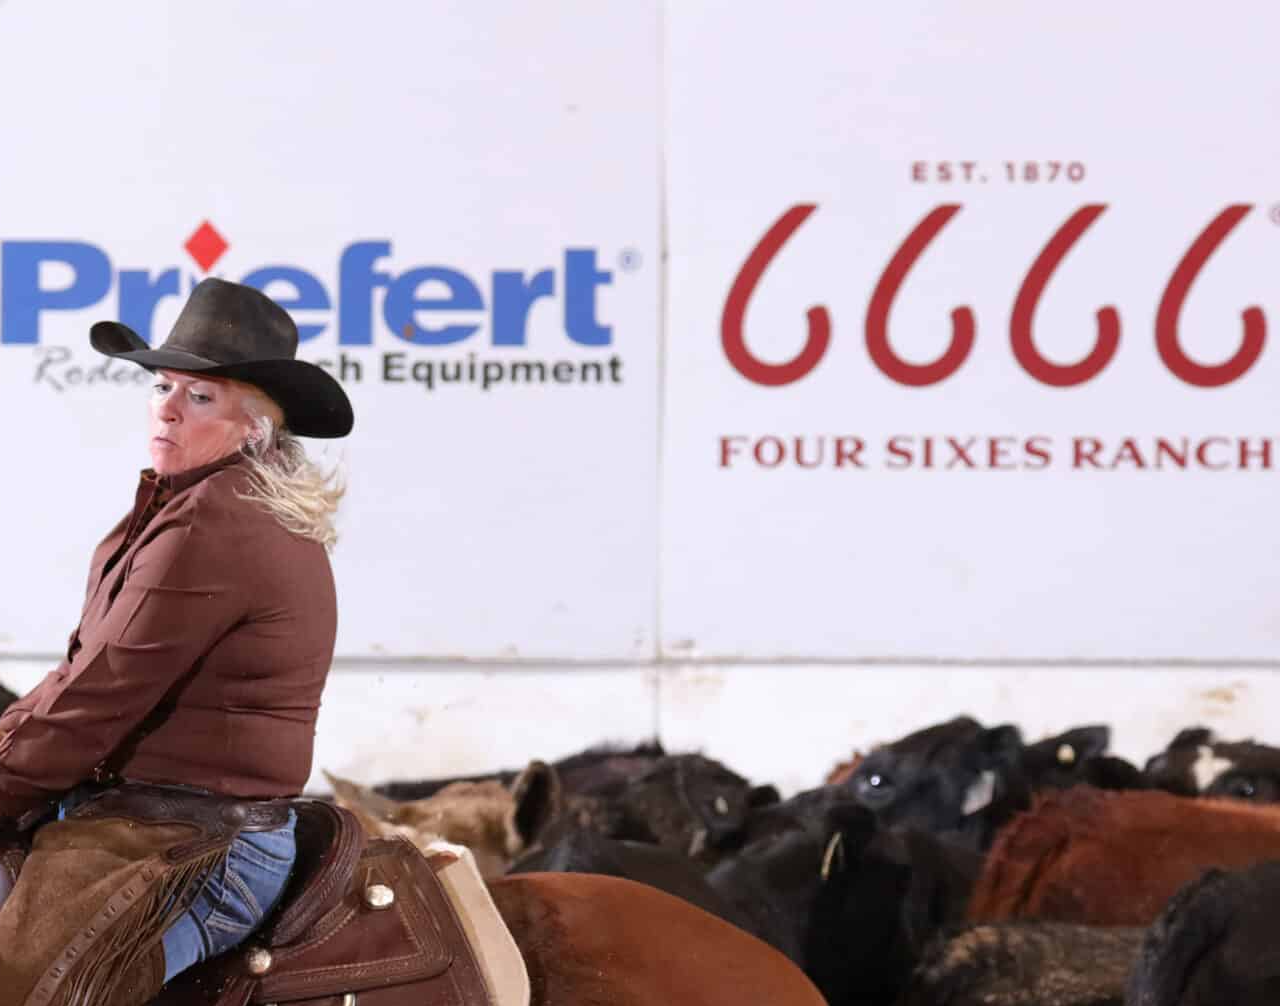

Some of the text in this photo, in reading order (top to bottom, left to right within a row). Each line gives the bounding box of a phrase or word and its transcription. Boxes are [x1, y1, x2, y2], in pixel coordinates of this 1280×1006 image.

[911, 161, 1086, 184] EST. 1870
[380, 352, 624, 390] Equipment
[718, 435, 1275, 470] FOUR SIXES RANCH
